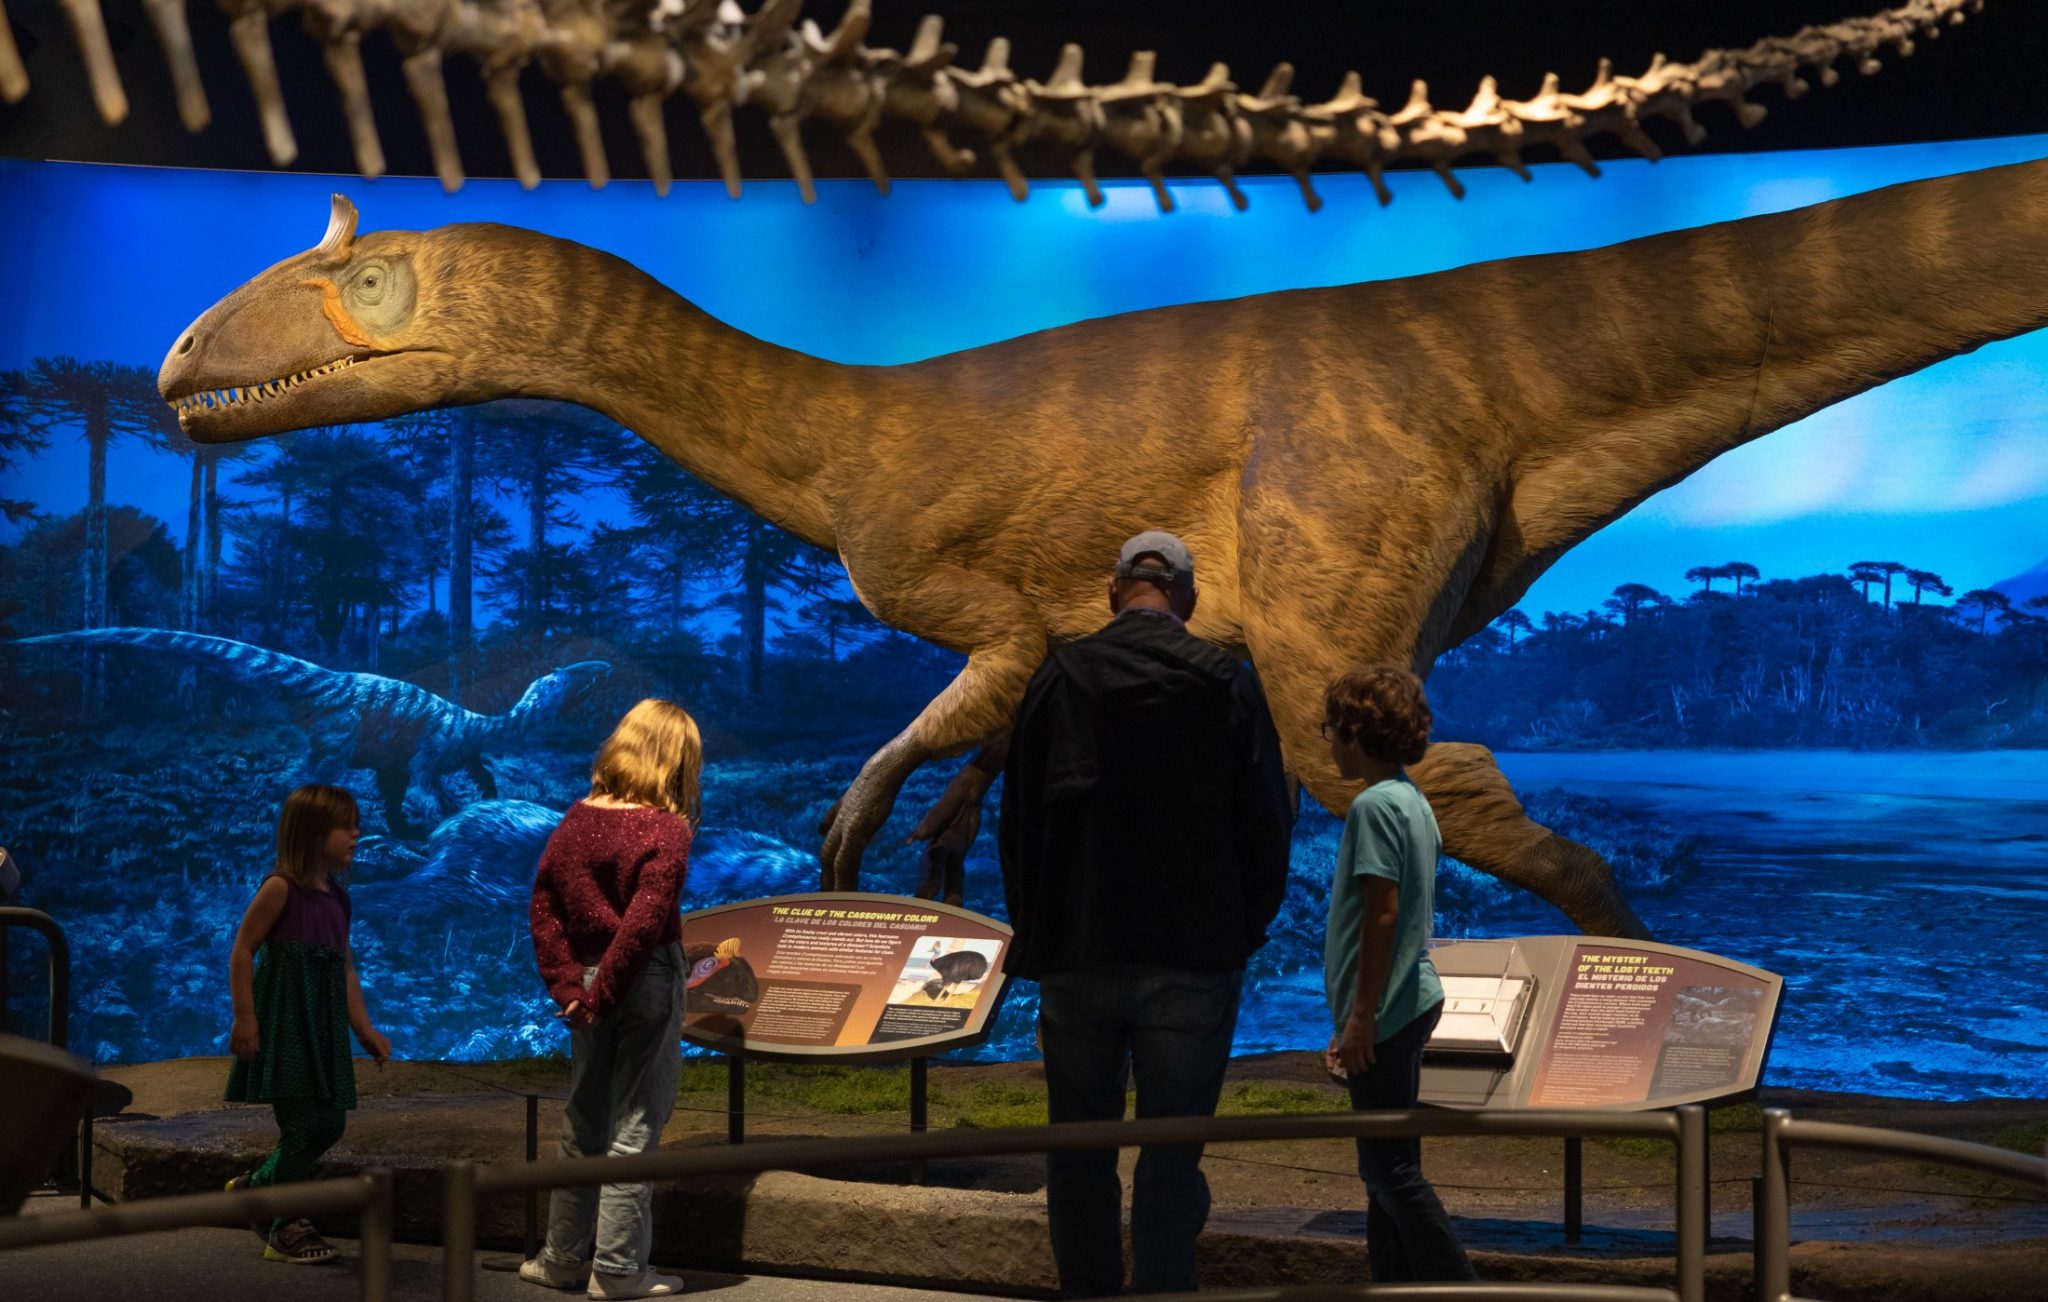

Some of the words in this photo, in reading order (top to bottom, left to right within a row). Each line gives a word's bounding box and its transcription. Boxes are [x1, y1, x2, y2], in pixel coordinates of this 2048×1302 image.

[790, 908, 814, 916] CLUE
[848, 912, 902, 920] CASSOWARY
[904, 914, 938, 922] COLORS
[838, 920, 872, 928] COLORES
[889, 923, 927, 931] CASUARIO
[1602, 956, 1648, 964] MYSTERY
[1594, 965, 1612, 973] THE
[1614, 966, 1640, 974] LOST
[1642, 966, 1674, 974] TEETH
[1591, 974, 1633, 982] MISTERIO
[1635, 975, 1648, 983] DE
[1574, 982, 1613, 990] DIENTES
[1614, 983, 1659, 992] PERDIDOS
